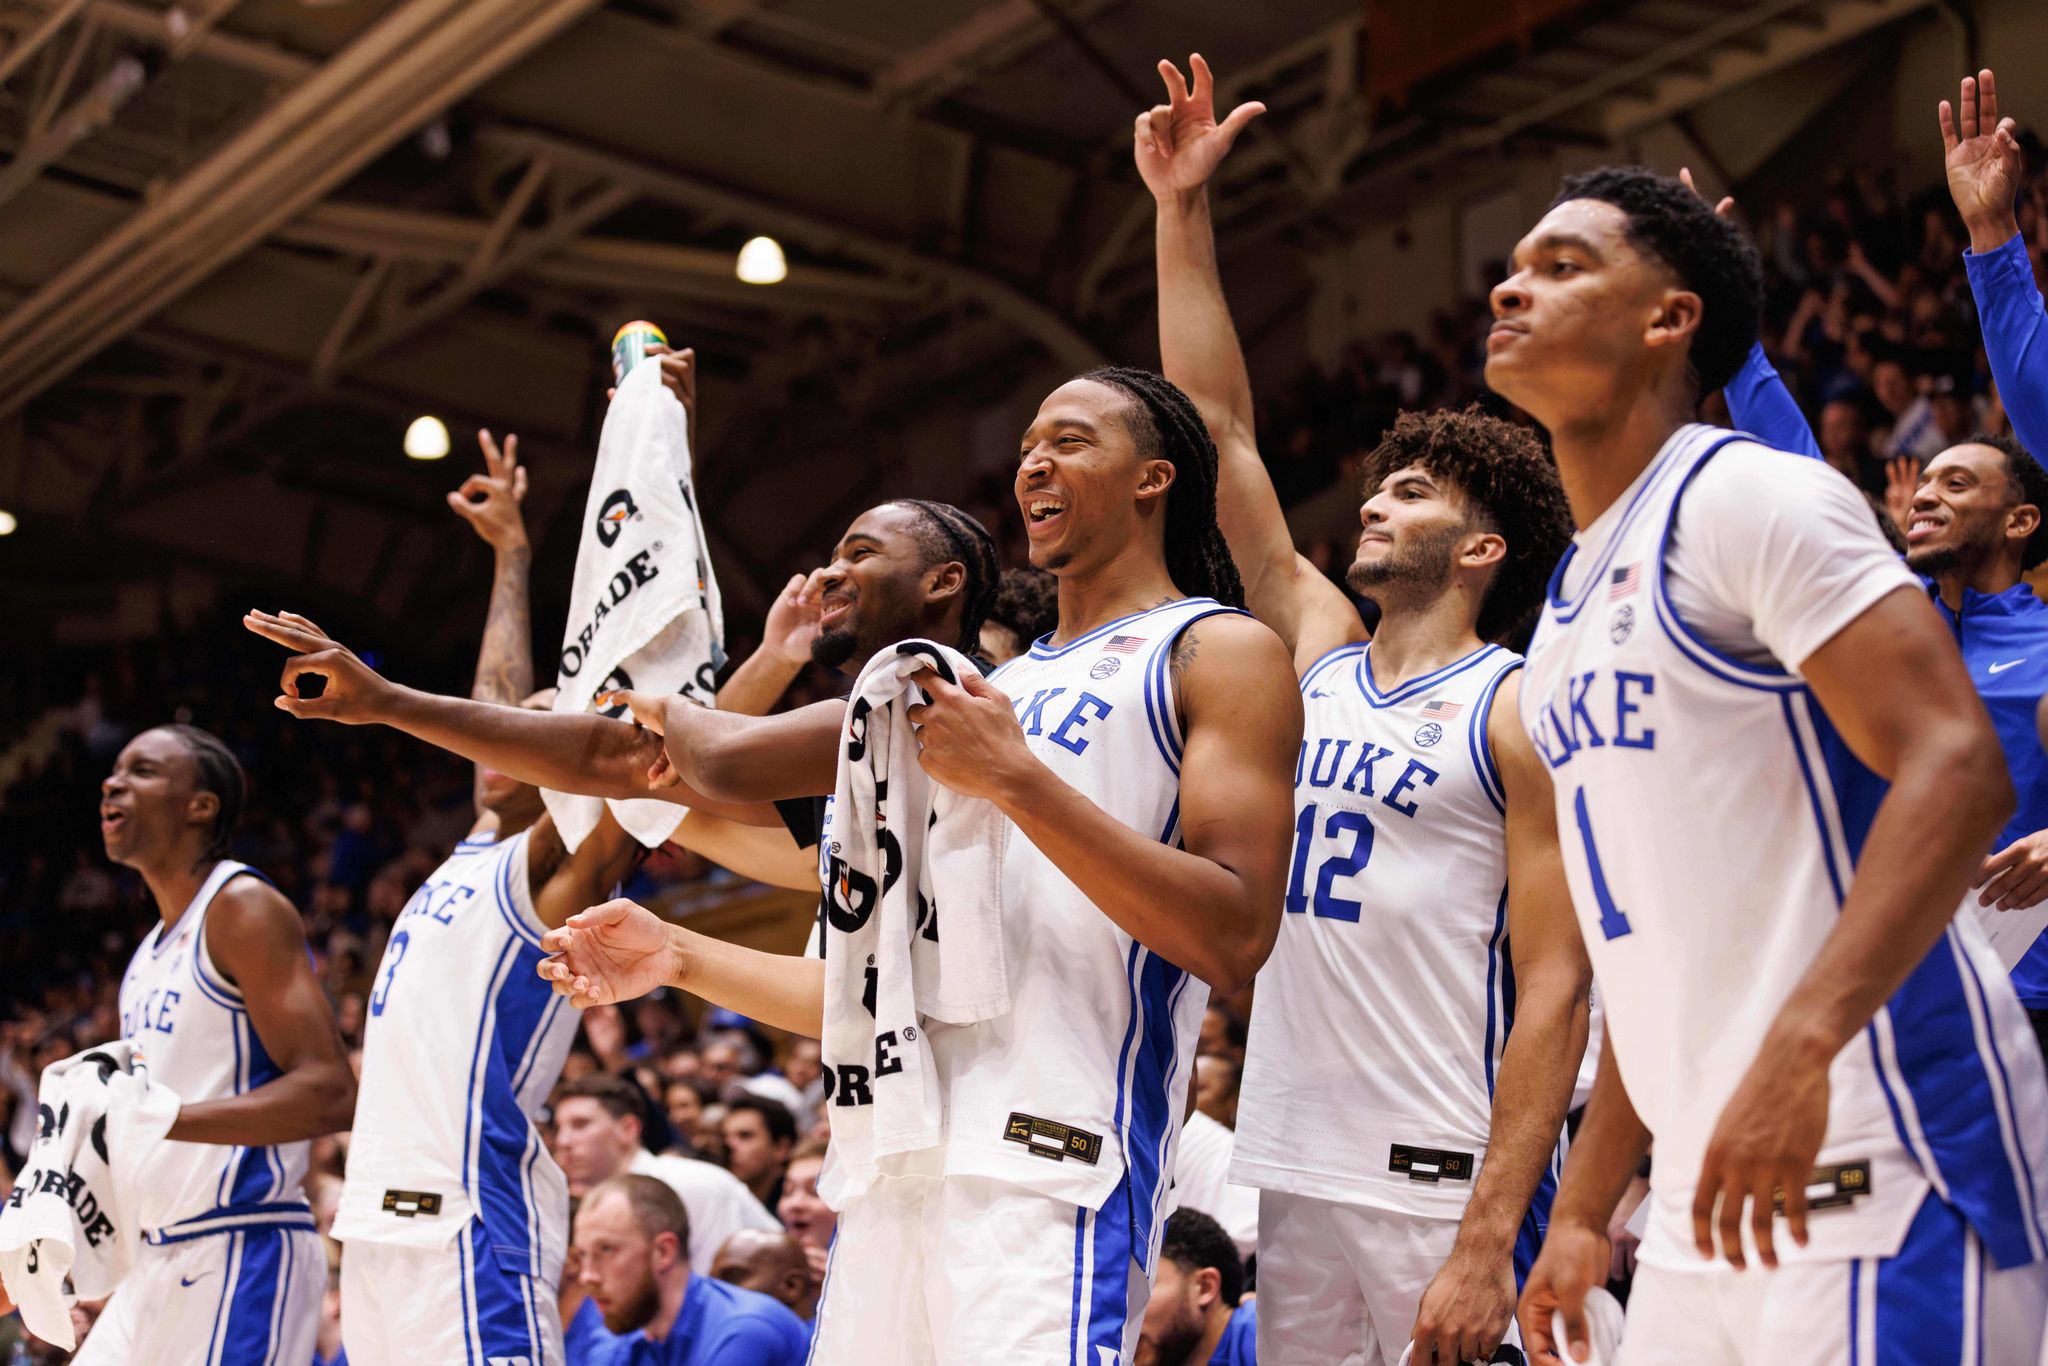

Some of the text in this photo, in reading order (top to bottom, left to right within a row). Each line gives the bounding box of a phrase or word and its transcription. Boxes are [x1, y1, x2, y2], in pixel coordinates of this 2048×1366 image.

[557, 549, 660, 684] ORADE
[1012, 687, 1114, 757] KE
[1286, 804, 1375, 923] 12
[1575, 784, 1632, 940] 1
[1071, 1136, 1087, 1151] 50
